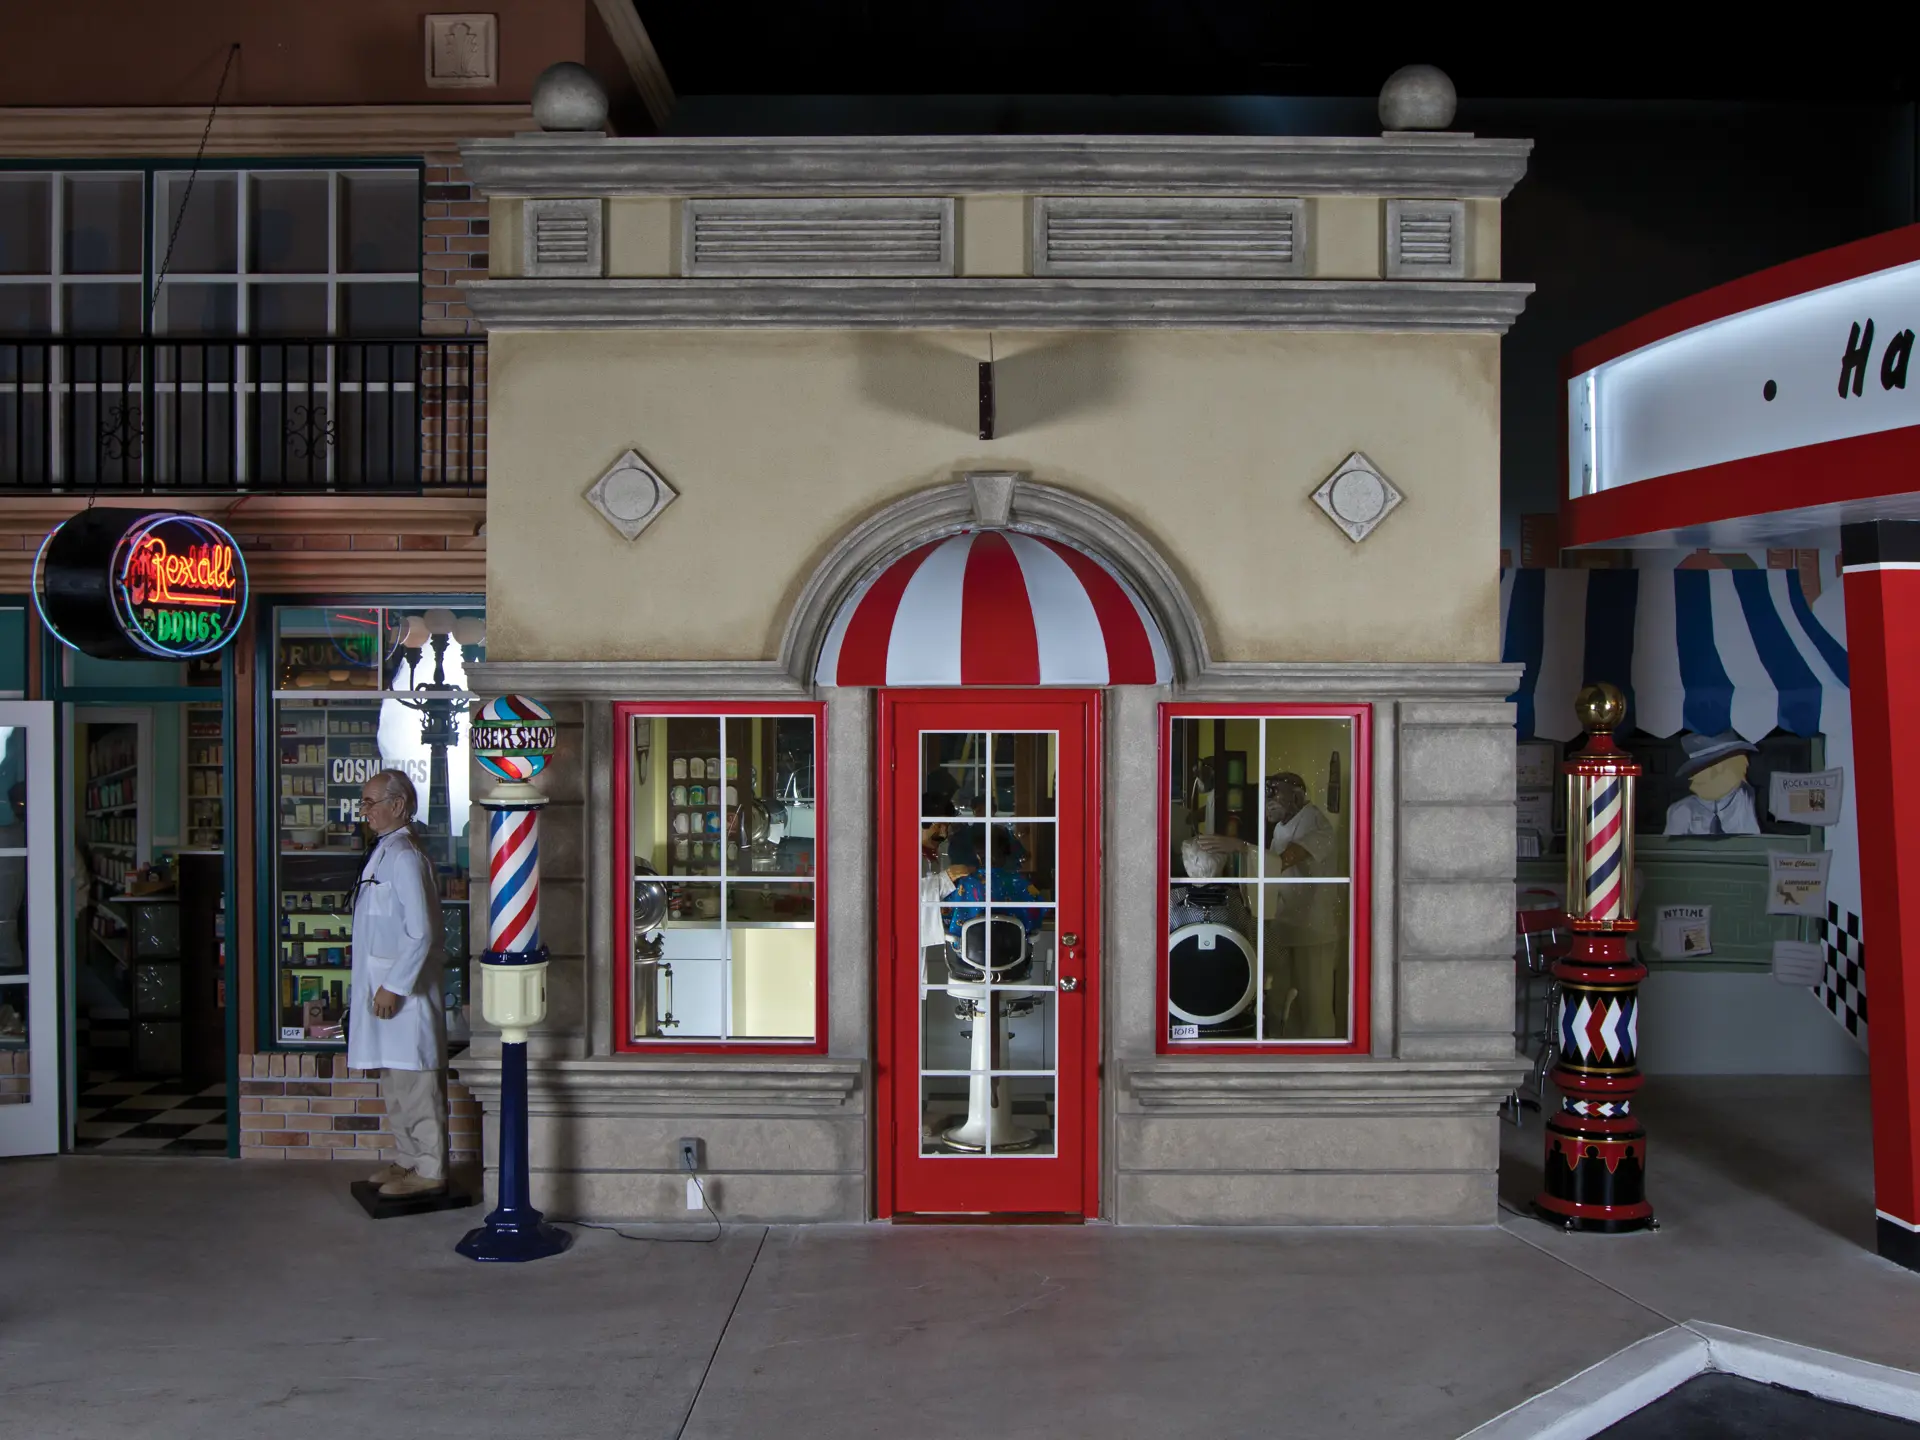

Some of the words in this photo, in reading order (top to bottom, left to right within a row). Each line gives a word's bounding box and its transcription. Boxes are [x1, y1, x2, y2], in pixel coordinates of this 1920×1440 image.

[1838, 317, 1916, 400] Ha
[144, 538, 237, 604] Rexall
[157, 610, 222, 643] DRUGS
[517, 727, 555, 749] SHOP
[1174, 1027, 1195, 1036] 1018
